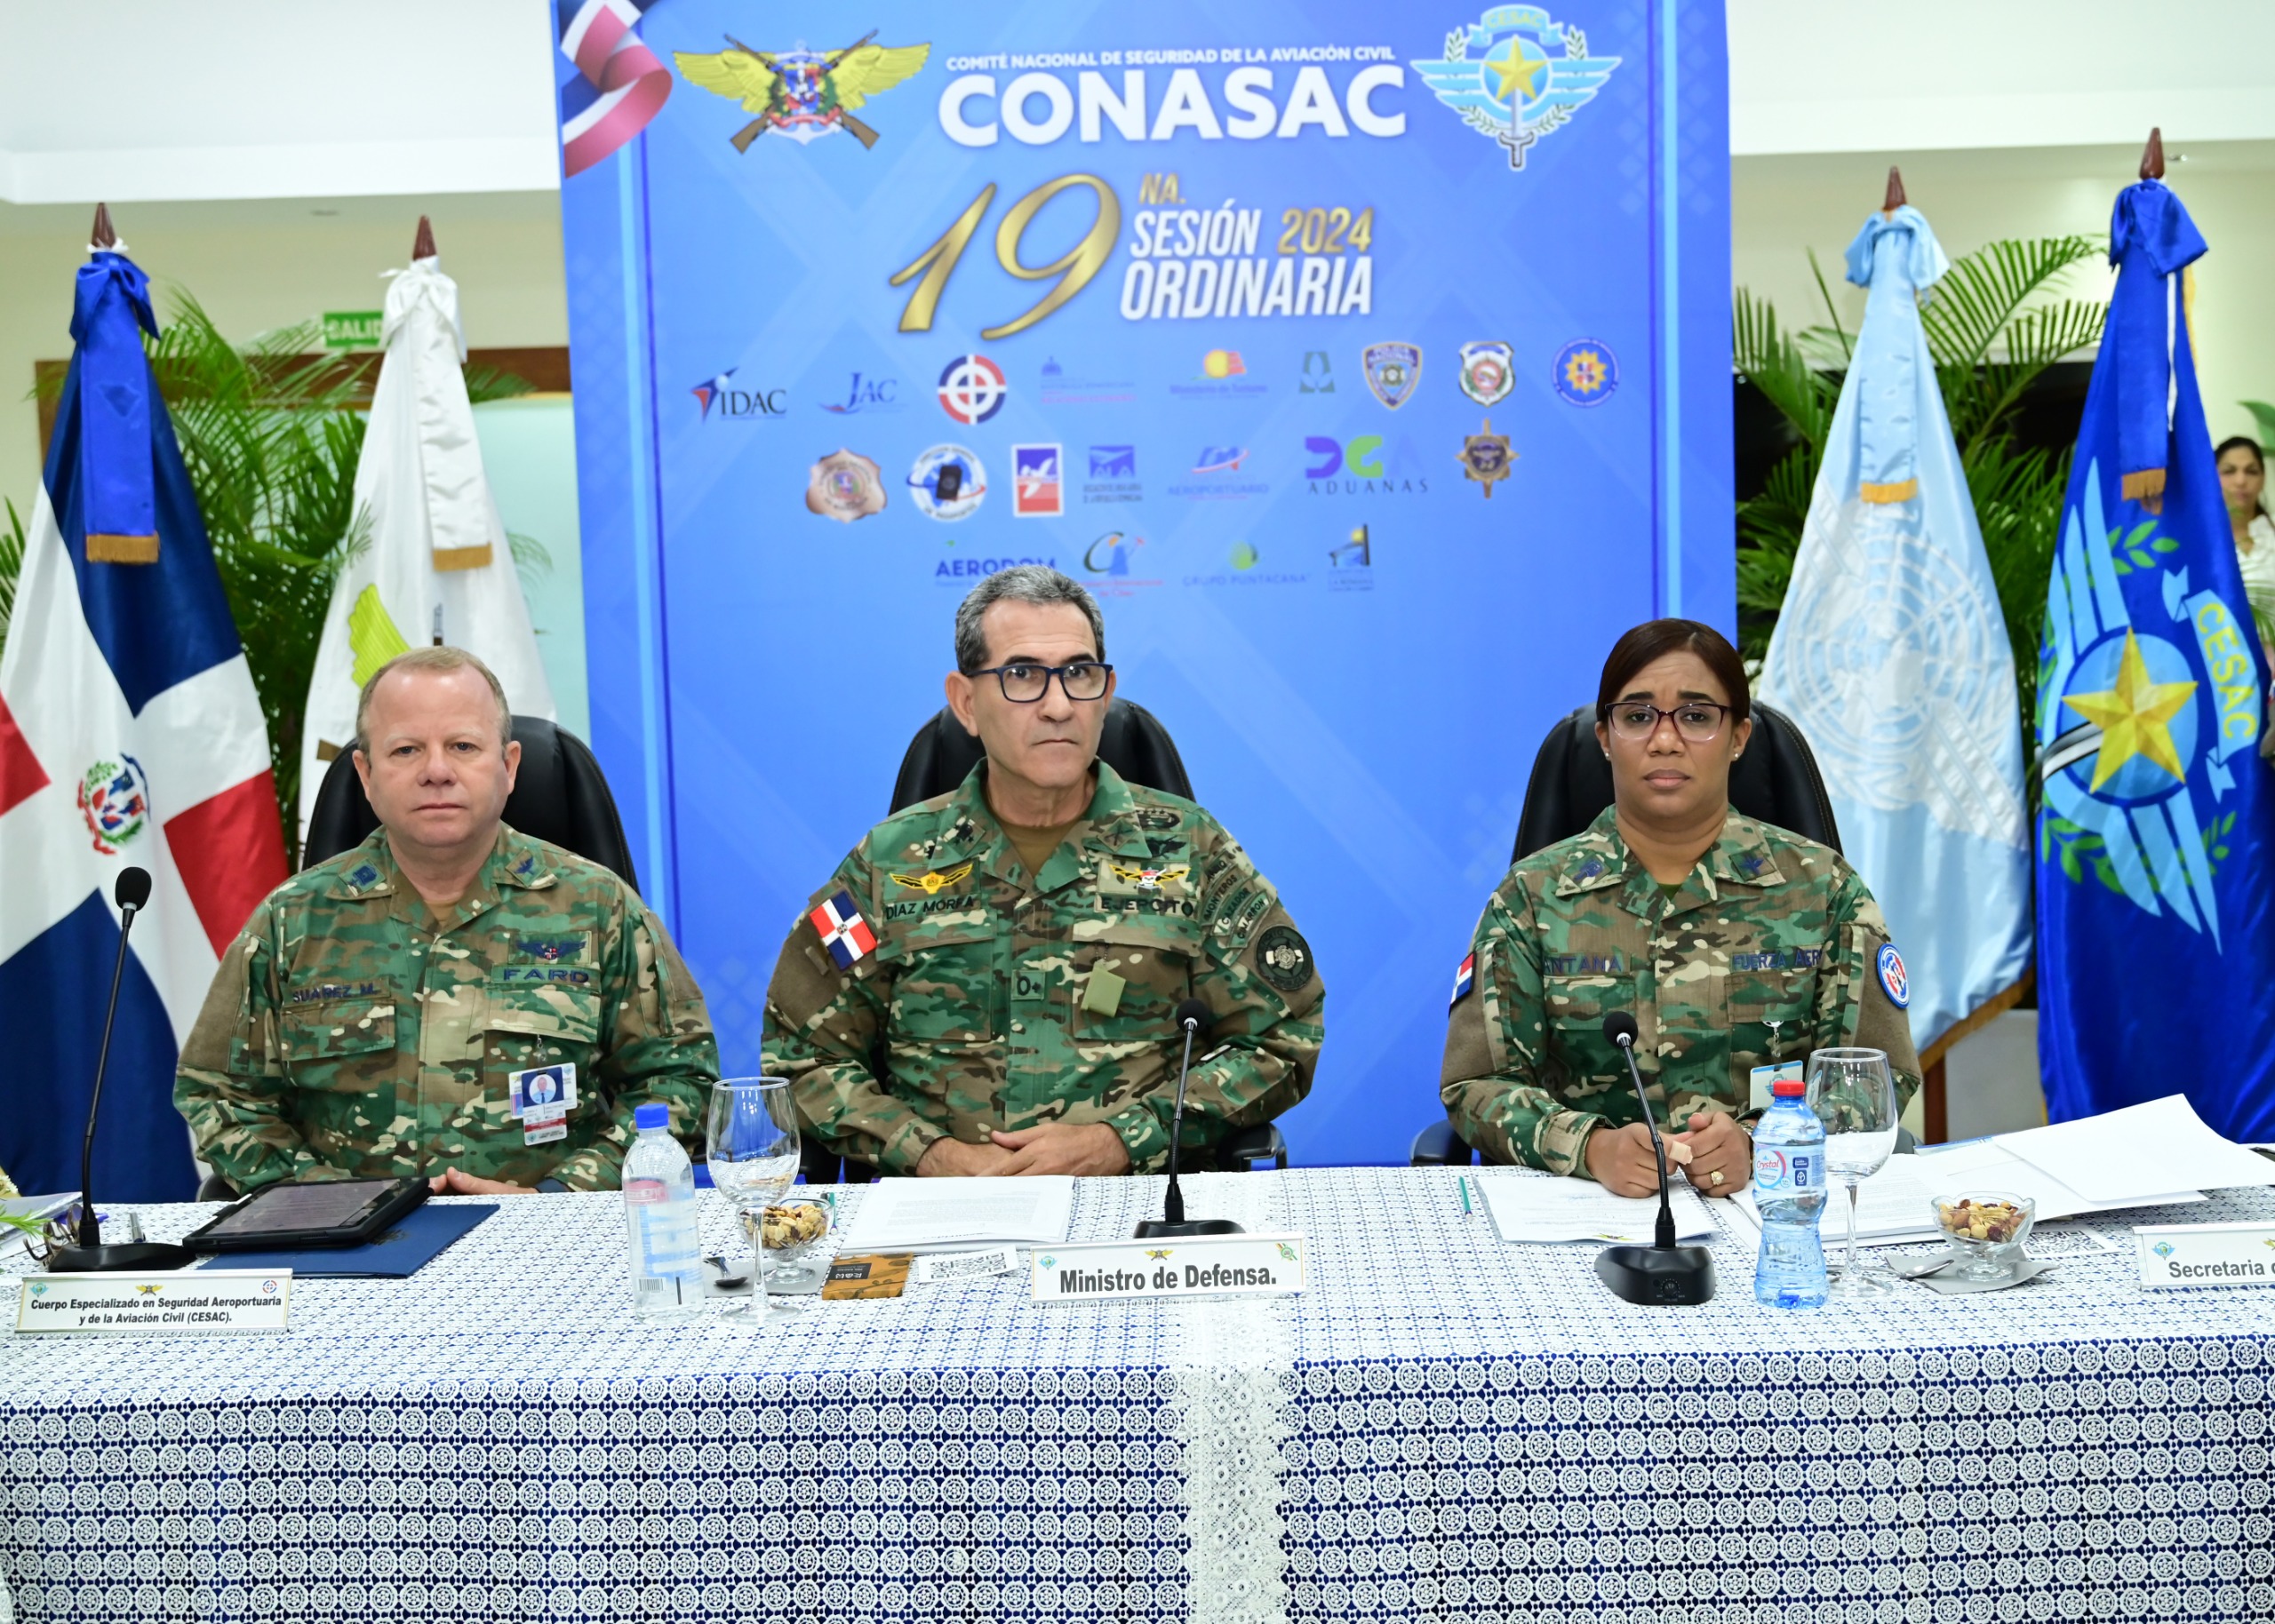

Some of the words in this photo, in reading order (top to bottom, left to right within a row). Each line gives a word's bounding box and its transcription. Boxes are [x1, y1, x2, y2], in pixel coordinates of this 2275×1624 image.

[1486, 11, 1544, 29] CESAC
[946, 52, 1009, 71] COMITÉ
[1011, 51, 1098, 68] NACIONAL
[1101, 51, 1122, 66] DE
[1125, 49, 1218, 65] SEGURIDAD
[1221, 48, 1243, 63] DE
[1245, 48, 1267, 62] LA
[1270, 44, 1352, 62] AVIACIÓN
[1353, 46, 1396, 61] CIVIL
[938, 64, 1406, 147] CONASAC
[1138, 173, 1187, 204] NA.
[1130, 199, 1261, 258] SESIÓN
[1277, 206, 1375, 254] 2024
[890, 173, 1122, 341] 19
[1120, 255, 1373, 321] ORDINARIA
[328, 318, 382, 340] SALID
[845, 371, 898, 409] JAC
[720, 389, 787, 415] IDAC
[1308, 478, 1428, 496] ADUANAS
[1182, 575, 1227, 587] GRUPO
[1231, 573, 1307, 585] PUNTACANA
[2197, 602, 2257, 739] CESAC
[885, 903, 917, 920] DIAZ
[922, 896, 974, 913] MORFA
[1100, 896, 1194, 917] EJERCITO
[1203, 874, 1238, 920] MONTEROS
[1221, 888, 1250, 925] CAZADOR
[1544, 955, 1623, 974] ANTANA
[1733, 952, 1787, 970] FUERZA
[1795, 948, 1823, 967] AER
[503, 967, 589, 983] FARD
[292, 983, 352, 1003] SUAREZ
[1756, 1158, 1780, 1171] Crystal
[1059, 1267, 1146, 1294] Ministro
[1152, 1265, 1178, 1291] de
[1185, 1263, 1277, 1289] Defensa.
[2168, 1259, 2266, 1278] Secretaria
[31, 1299, 68, 1311] Cuerpo
[70, 1298, 140, 1311] Especializado
[158, 1297, 209, 1310] Seguridad
[212, 1295, 282, 1310] Aeroportuaria
[78, 1316, 86, 1326] y
[88, 1313, 101, 1324] de
[103, 1313, 113, 1324] la
[116, 1312, 160, 1324] Aviación
[163, 1312, 185, 1323] Civil
[188, 1311, 232, 1325] (CESAC).
